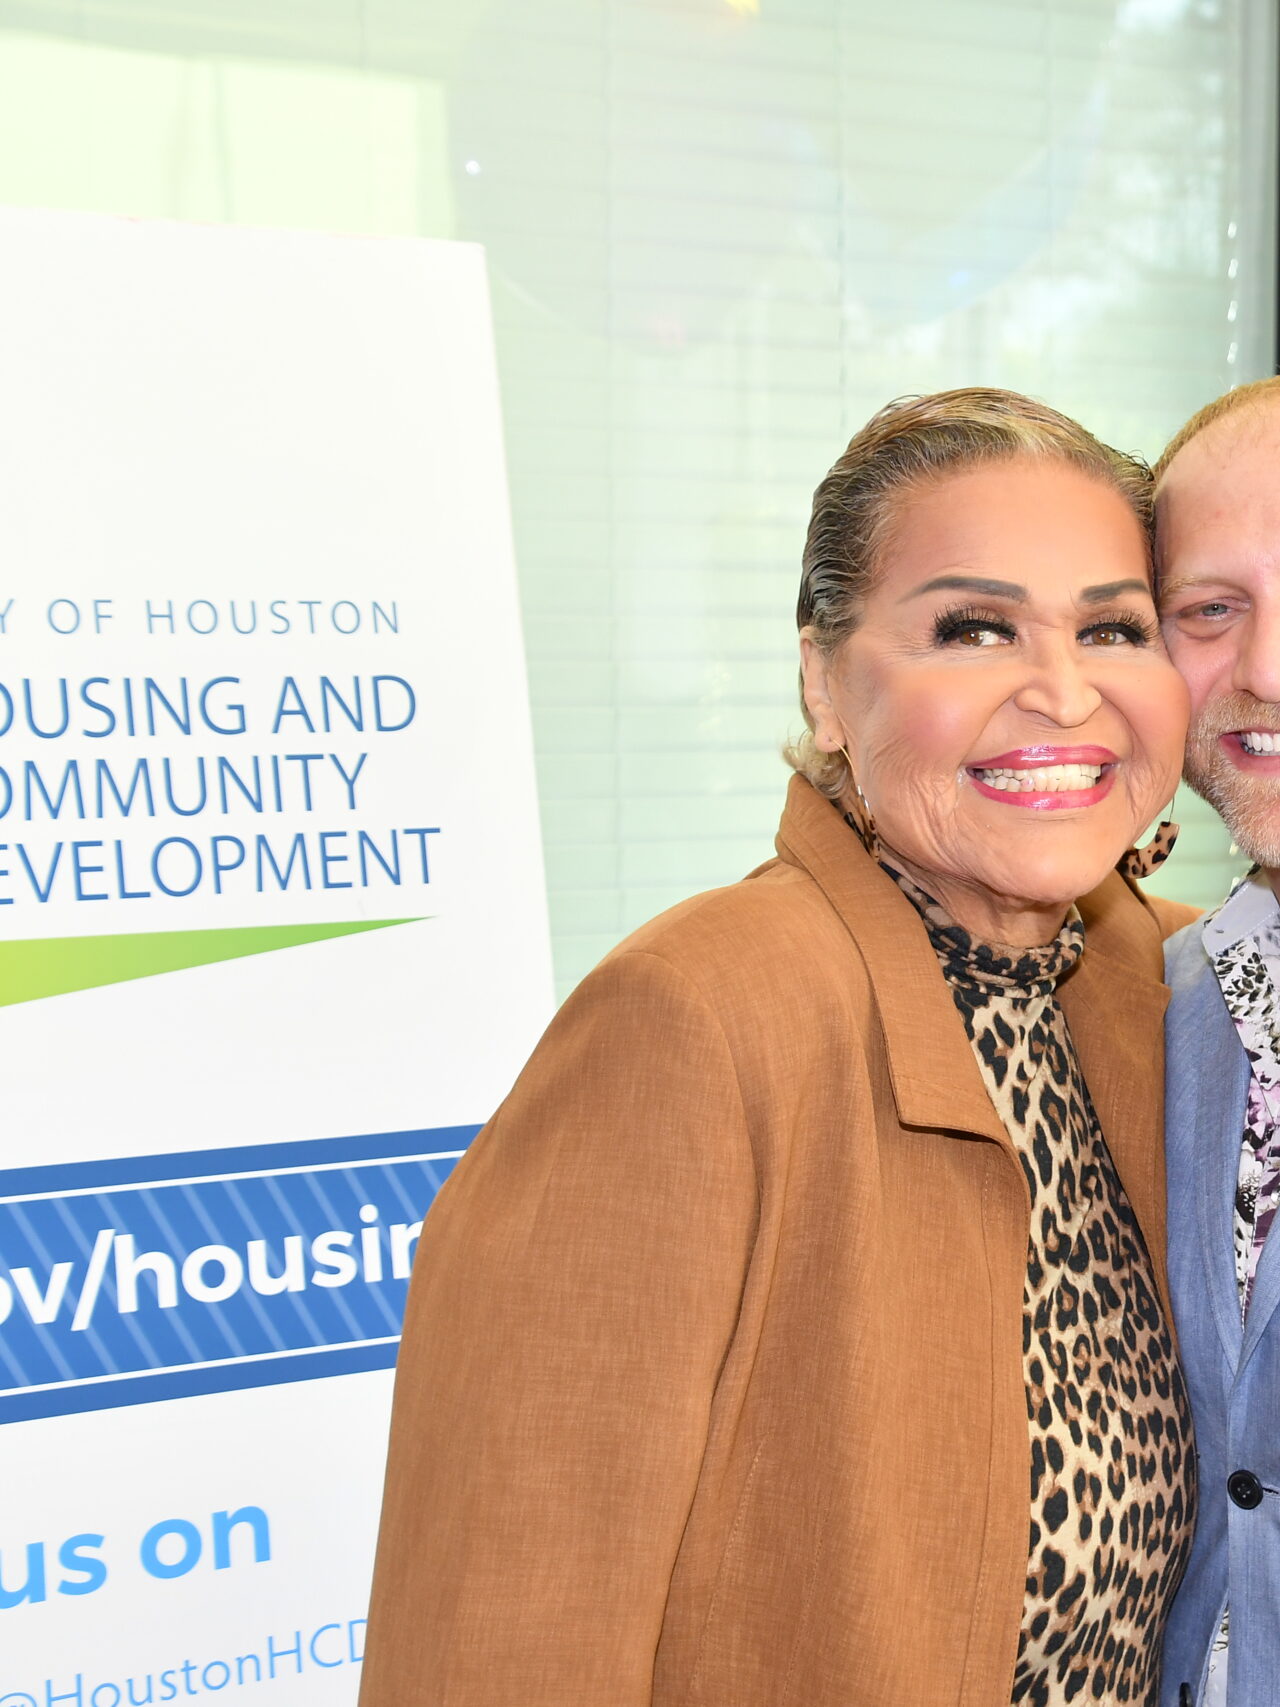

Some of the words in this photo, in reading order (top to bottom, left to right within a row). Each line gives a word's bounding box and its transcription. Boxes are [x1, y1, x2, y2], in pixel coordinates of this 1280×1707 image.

[47, 598, 114, 635] OF
[146, 598, 400, 635] HOUSTON
[0, 675, 248, 740] USING
[271, 674, 417, 735] AND
[0, 752, 369, 822] MMUNITY
[139, 1504, 272, 1581] on
